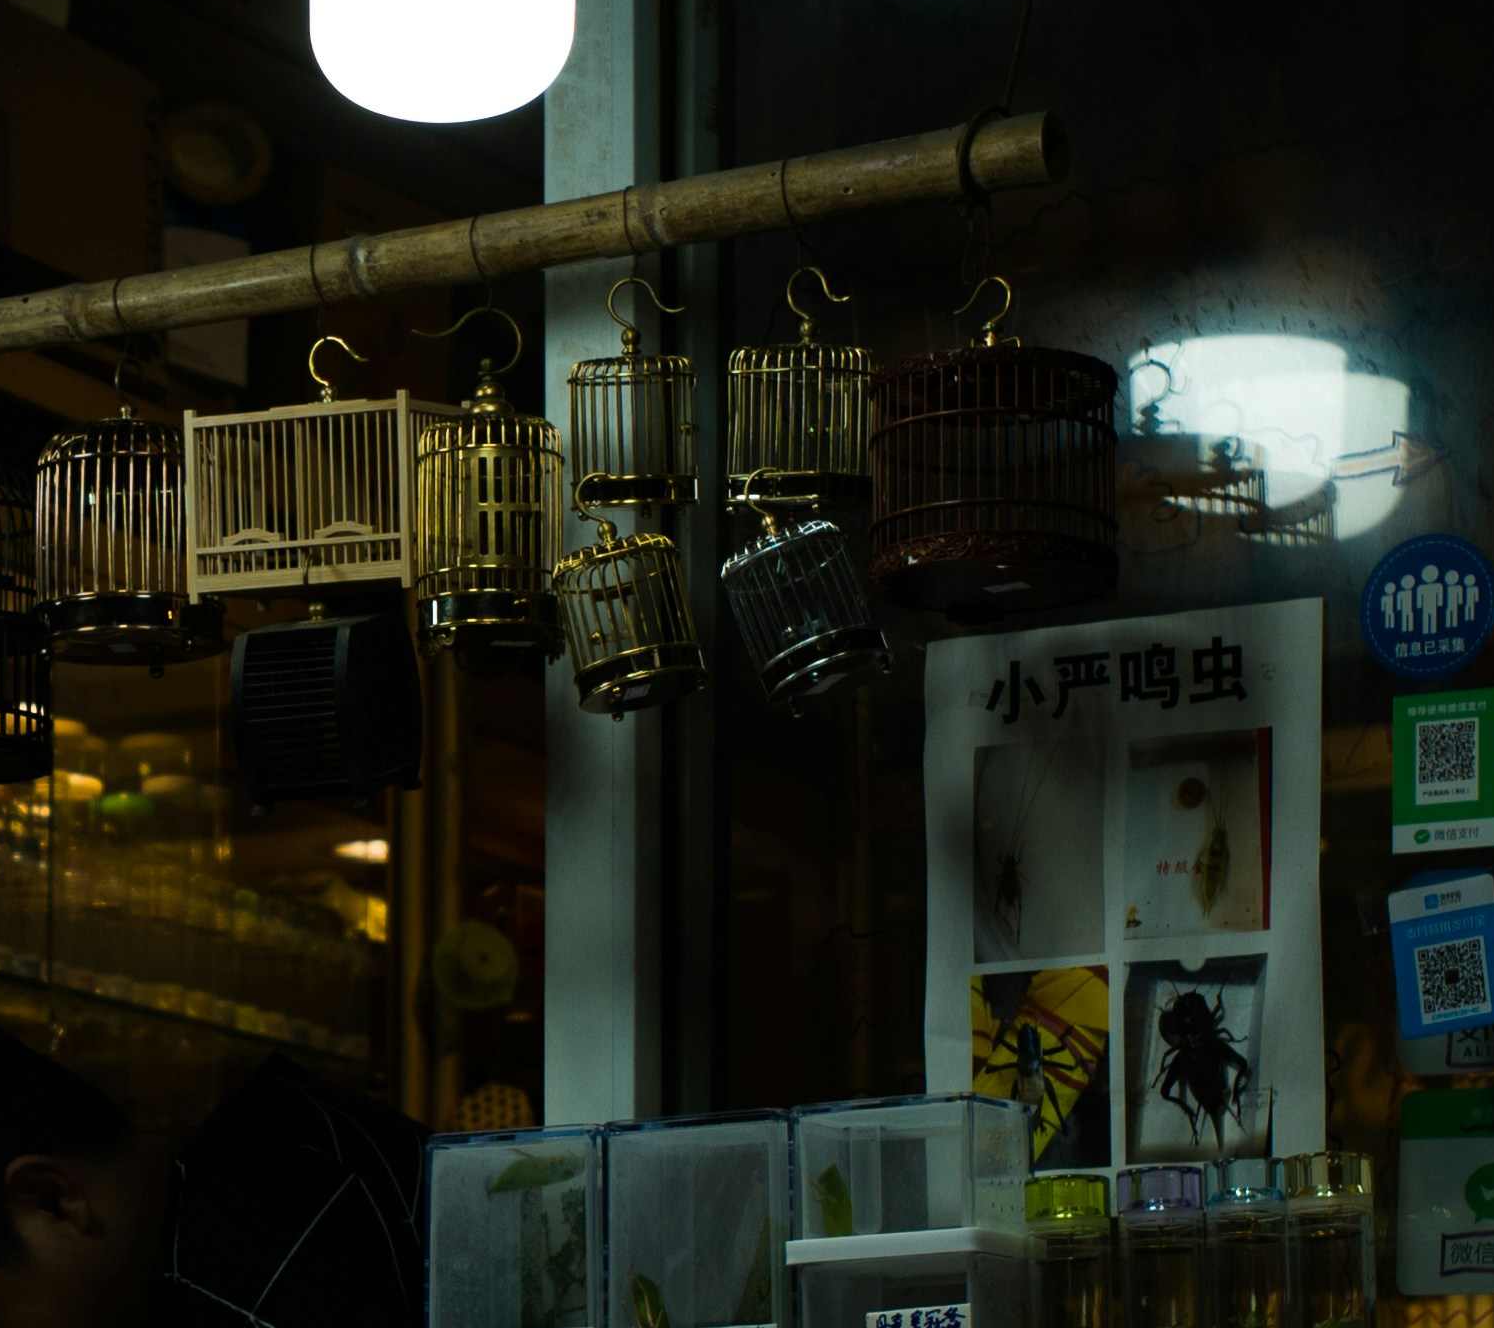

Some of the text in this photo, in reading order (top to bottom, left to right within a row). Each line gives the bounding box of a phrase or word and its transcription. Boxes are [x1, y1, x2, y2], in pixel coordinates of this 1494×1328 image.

[1394, 636, 1466, 659] 信息已采集
[985, 635, 1248, 725] 小严鸣虫
[1406, 699, 1488, 718] 推荐使用微信支付
[1433, 826, 1480, 842] 微信支付
